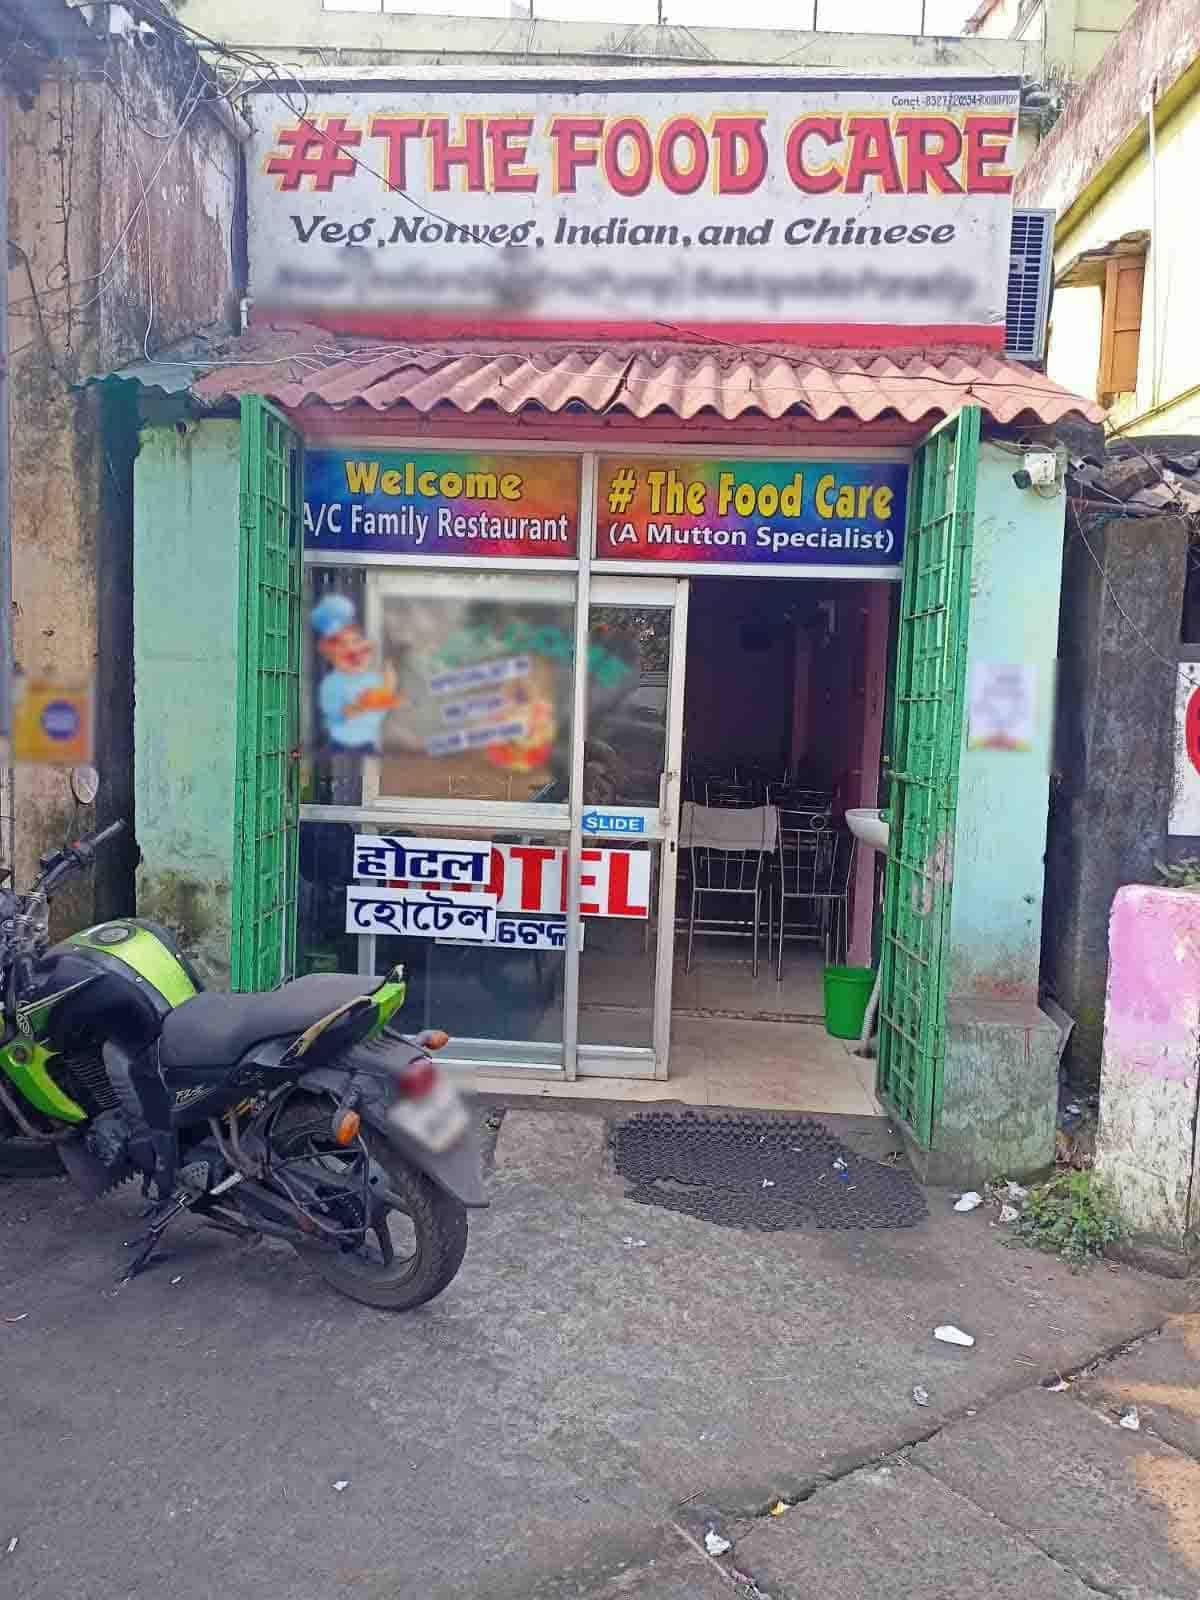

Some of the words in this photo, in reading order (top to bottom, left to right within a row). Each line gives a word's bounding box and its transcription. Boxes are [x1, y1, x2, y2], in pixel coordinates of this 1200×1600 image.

[263, 112, 364, 192] #
[369, 112, 539, 193] THE
[550, 112, 768, 197] FOOD
[786, 112, 1016, 195] CARE
[785, 218, 956, 247] Chinese
[345, 461, 523, 501] Welcome
[608, 468, 636, 513] #
[647, 470, 706, 516] The
[718, 472, 803, 517] Food
[815, 474, 894, 519] Care
[304, 503, 341, 536] A/C
[351, 505, 428, 545] Family
[438, 508, 568, 541] Restaurant
[608, 522, 637, 546] (A
[647, 524, 746, 545] Mutton
[756, 526, 894, 552] Specialist)
[586, 816, 641, 832] SLIDE
[357, 838, 490, 882] होटल
[350, 891, 493, 934] হোটেল
